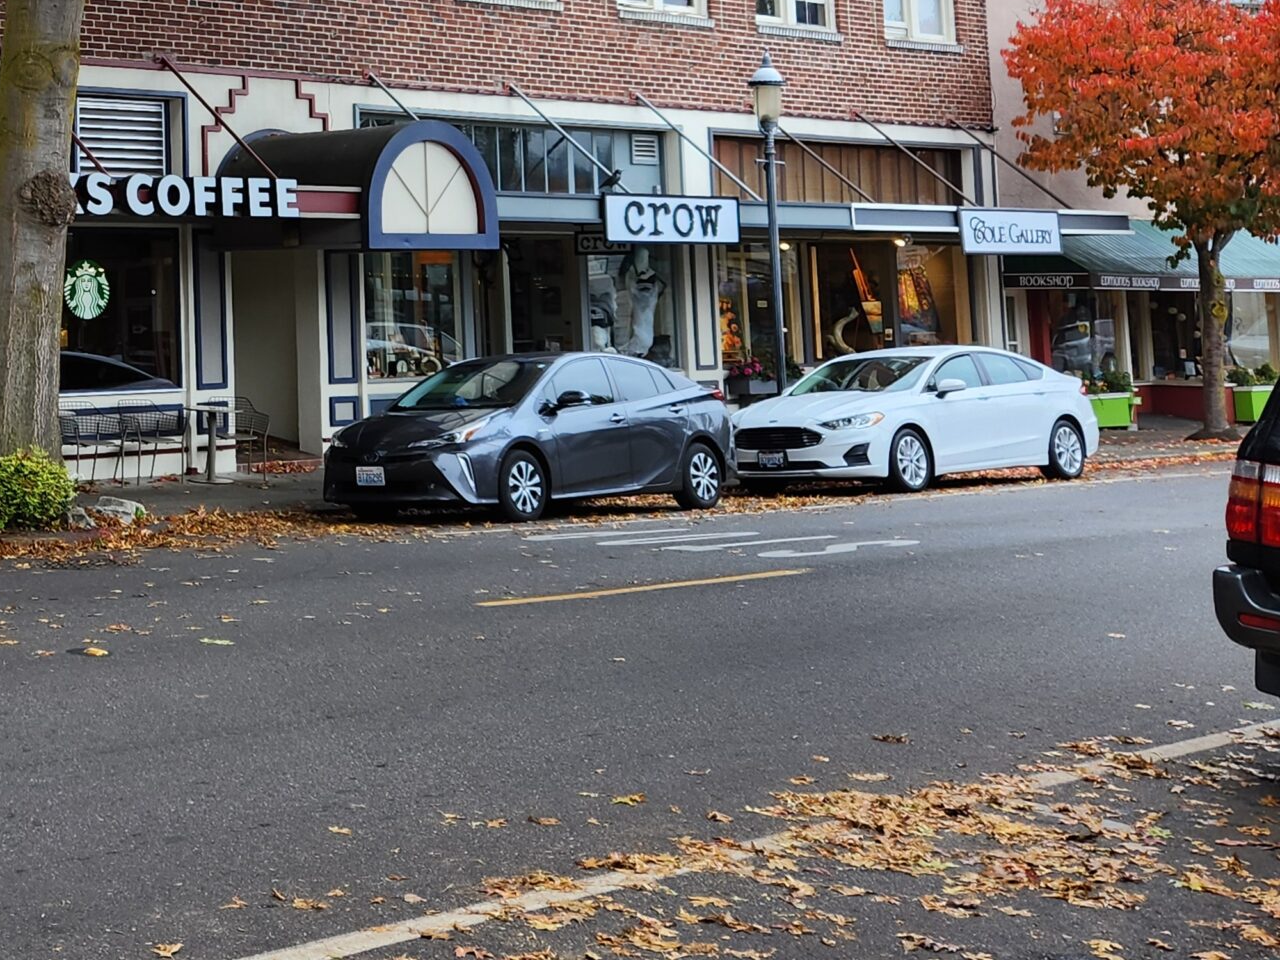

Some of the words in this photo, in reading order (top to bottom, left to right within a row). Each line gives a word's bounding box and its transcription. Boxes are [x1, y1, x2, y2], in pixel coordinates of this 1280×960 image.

[126, 172, 299, 218] COFFEE
[624, 200, 722, 238] crow
[969, 216, 1007, 245] COLE
[1009, 223, 1053, 244] GALLERY
[1019, 275, 1074, 289] BOOKSHOP
[1100, 275, 1131, 287] EDMONDS
[1132, 276, 1160, 289] BOOKSHOP
